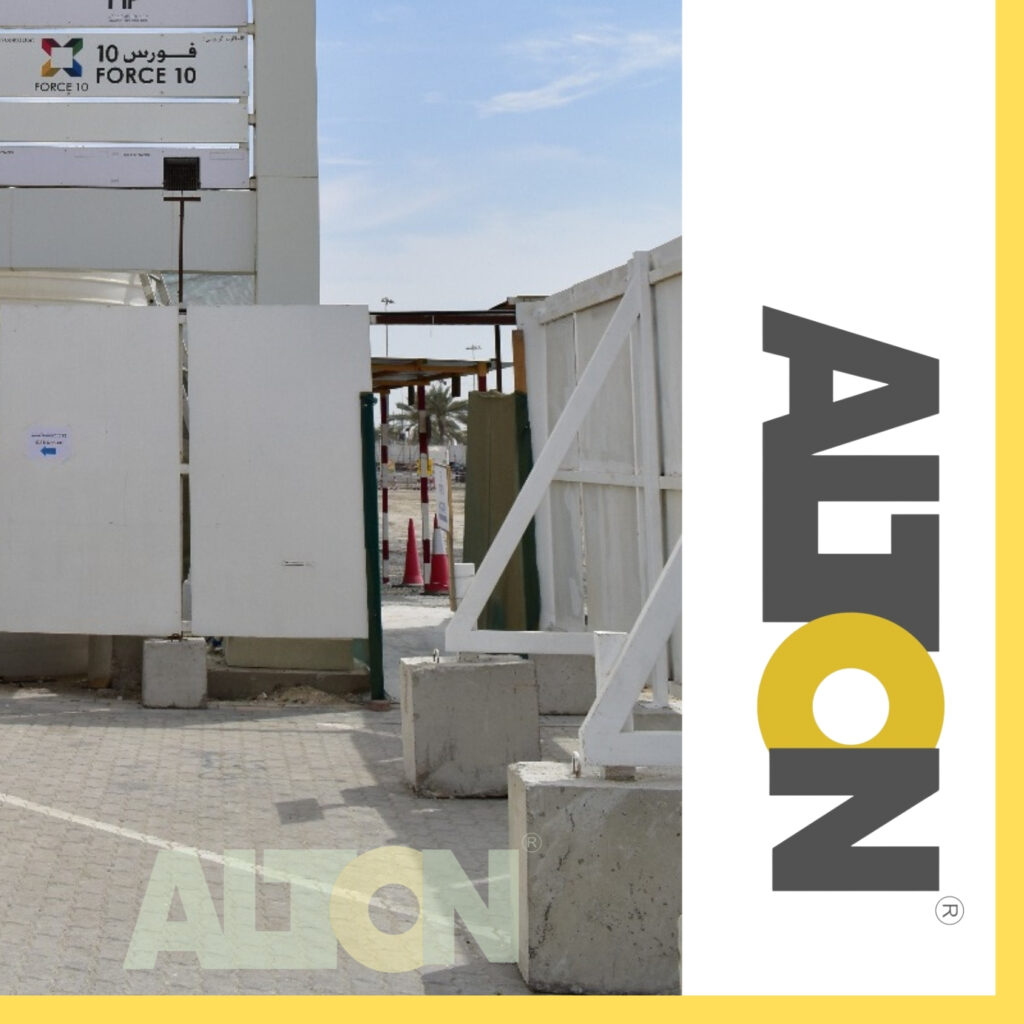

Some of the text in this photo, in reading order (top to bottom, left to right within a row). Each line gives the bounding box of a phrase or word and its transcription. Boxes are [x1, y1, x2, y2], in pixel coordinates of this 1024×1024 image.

[97, 44, 120, 63] 10
[96, 67, 197, 84] FORCE 10
[35, 82, 89, 92] FORCE 10
